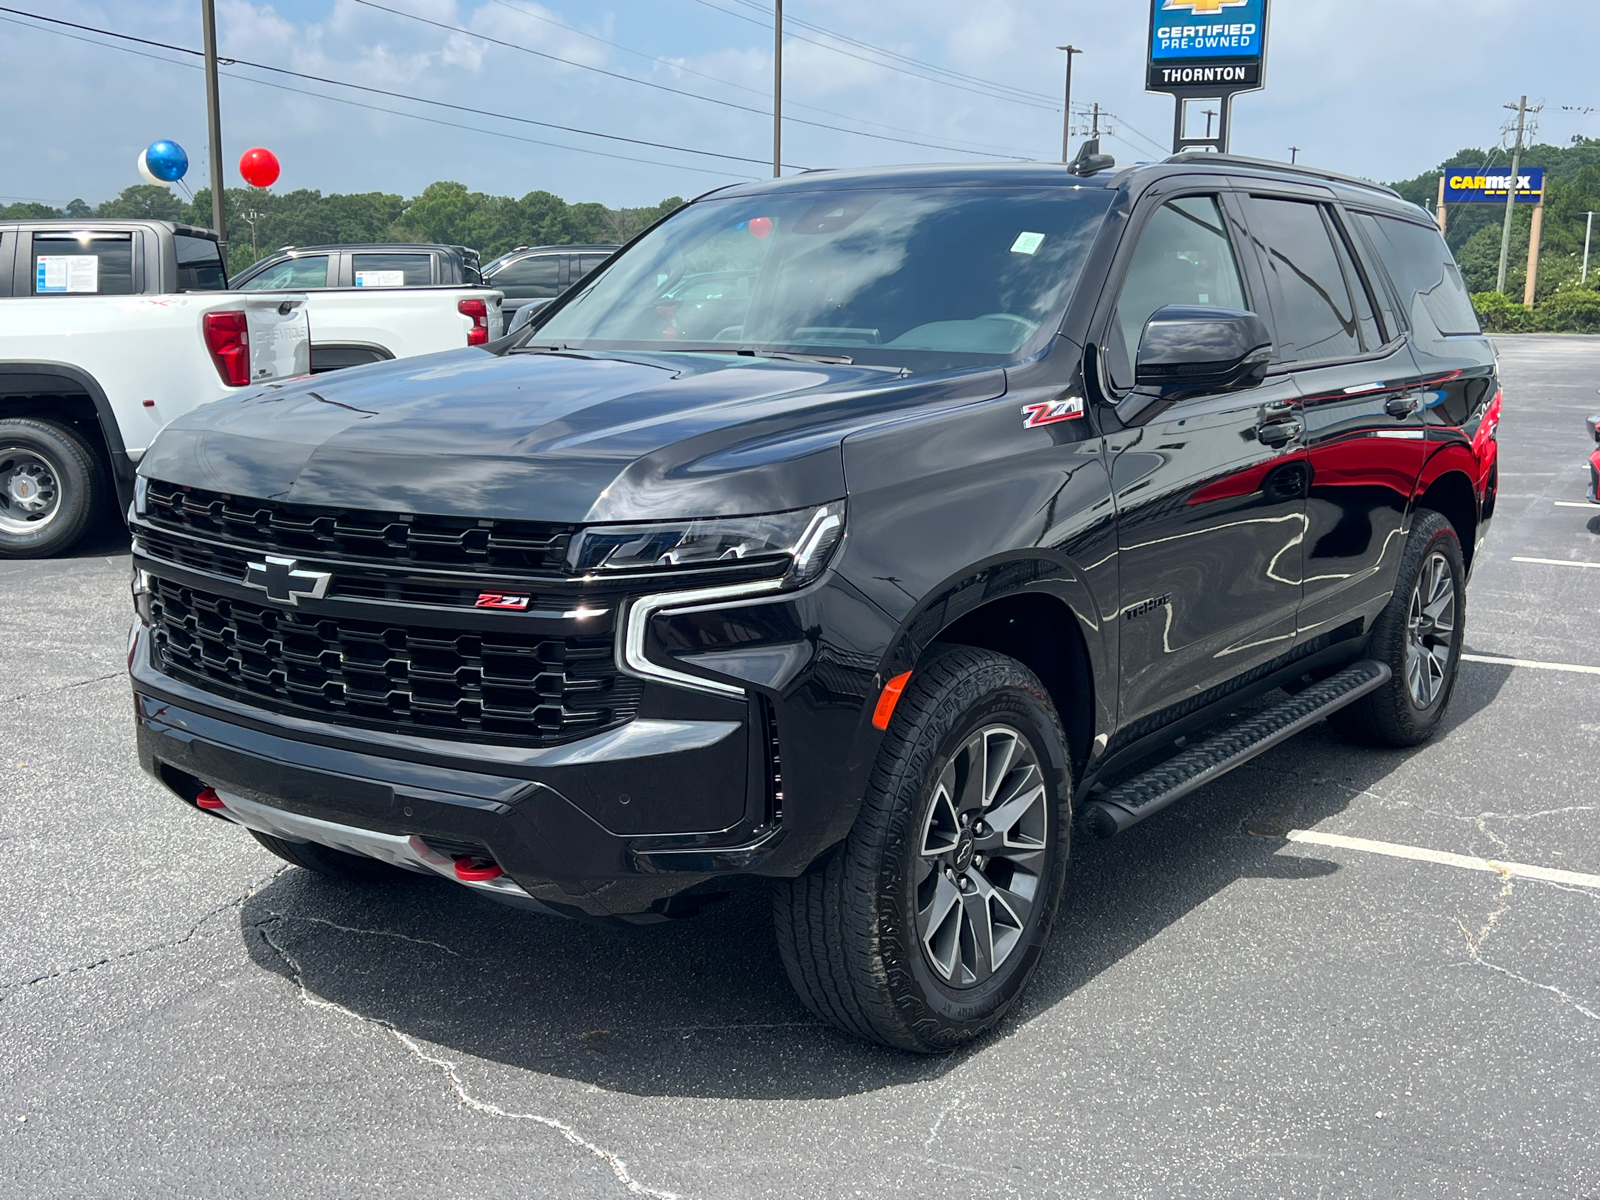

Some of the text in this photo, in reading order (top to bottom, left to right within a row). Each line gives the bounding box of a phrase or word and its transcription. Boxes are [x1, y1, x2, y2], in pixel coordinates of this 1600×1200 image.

[1157, 24, 1256, 38] CERTIFIED
[1161, 36, 1250, 49] PRE-OWNED
[1162, 67, 1245, 82] THORNTON
